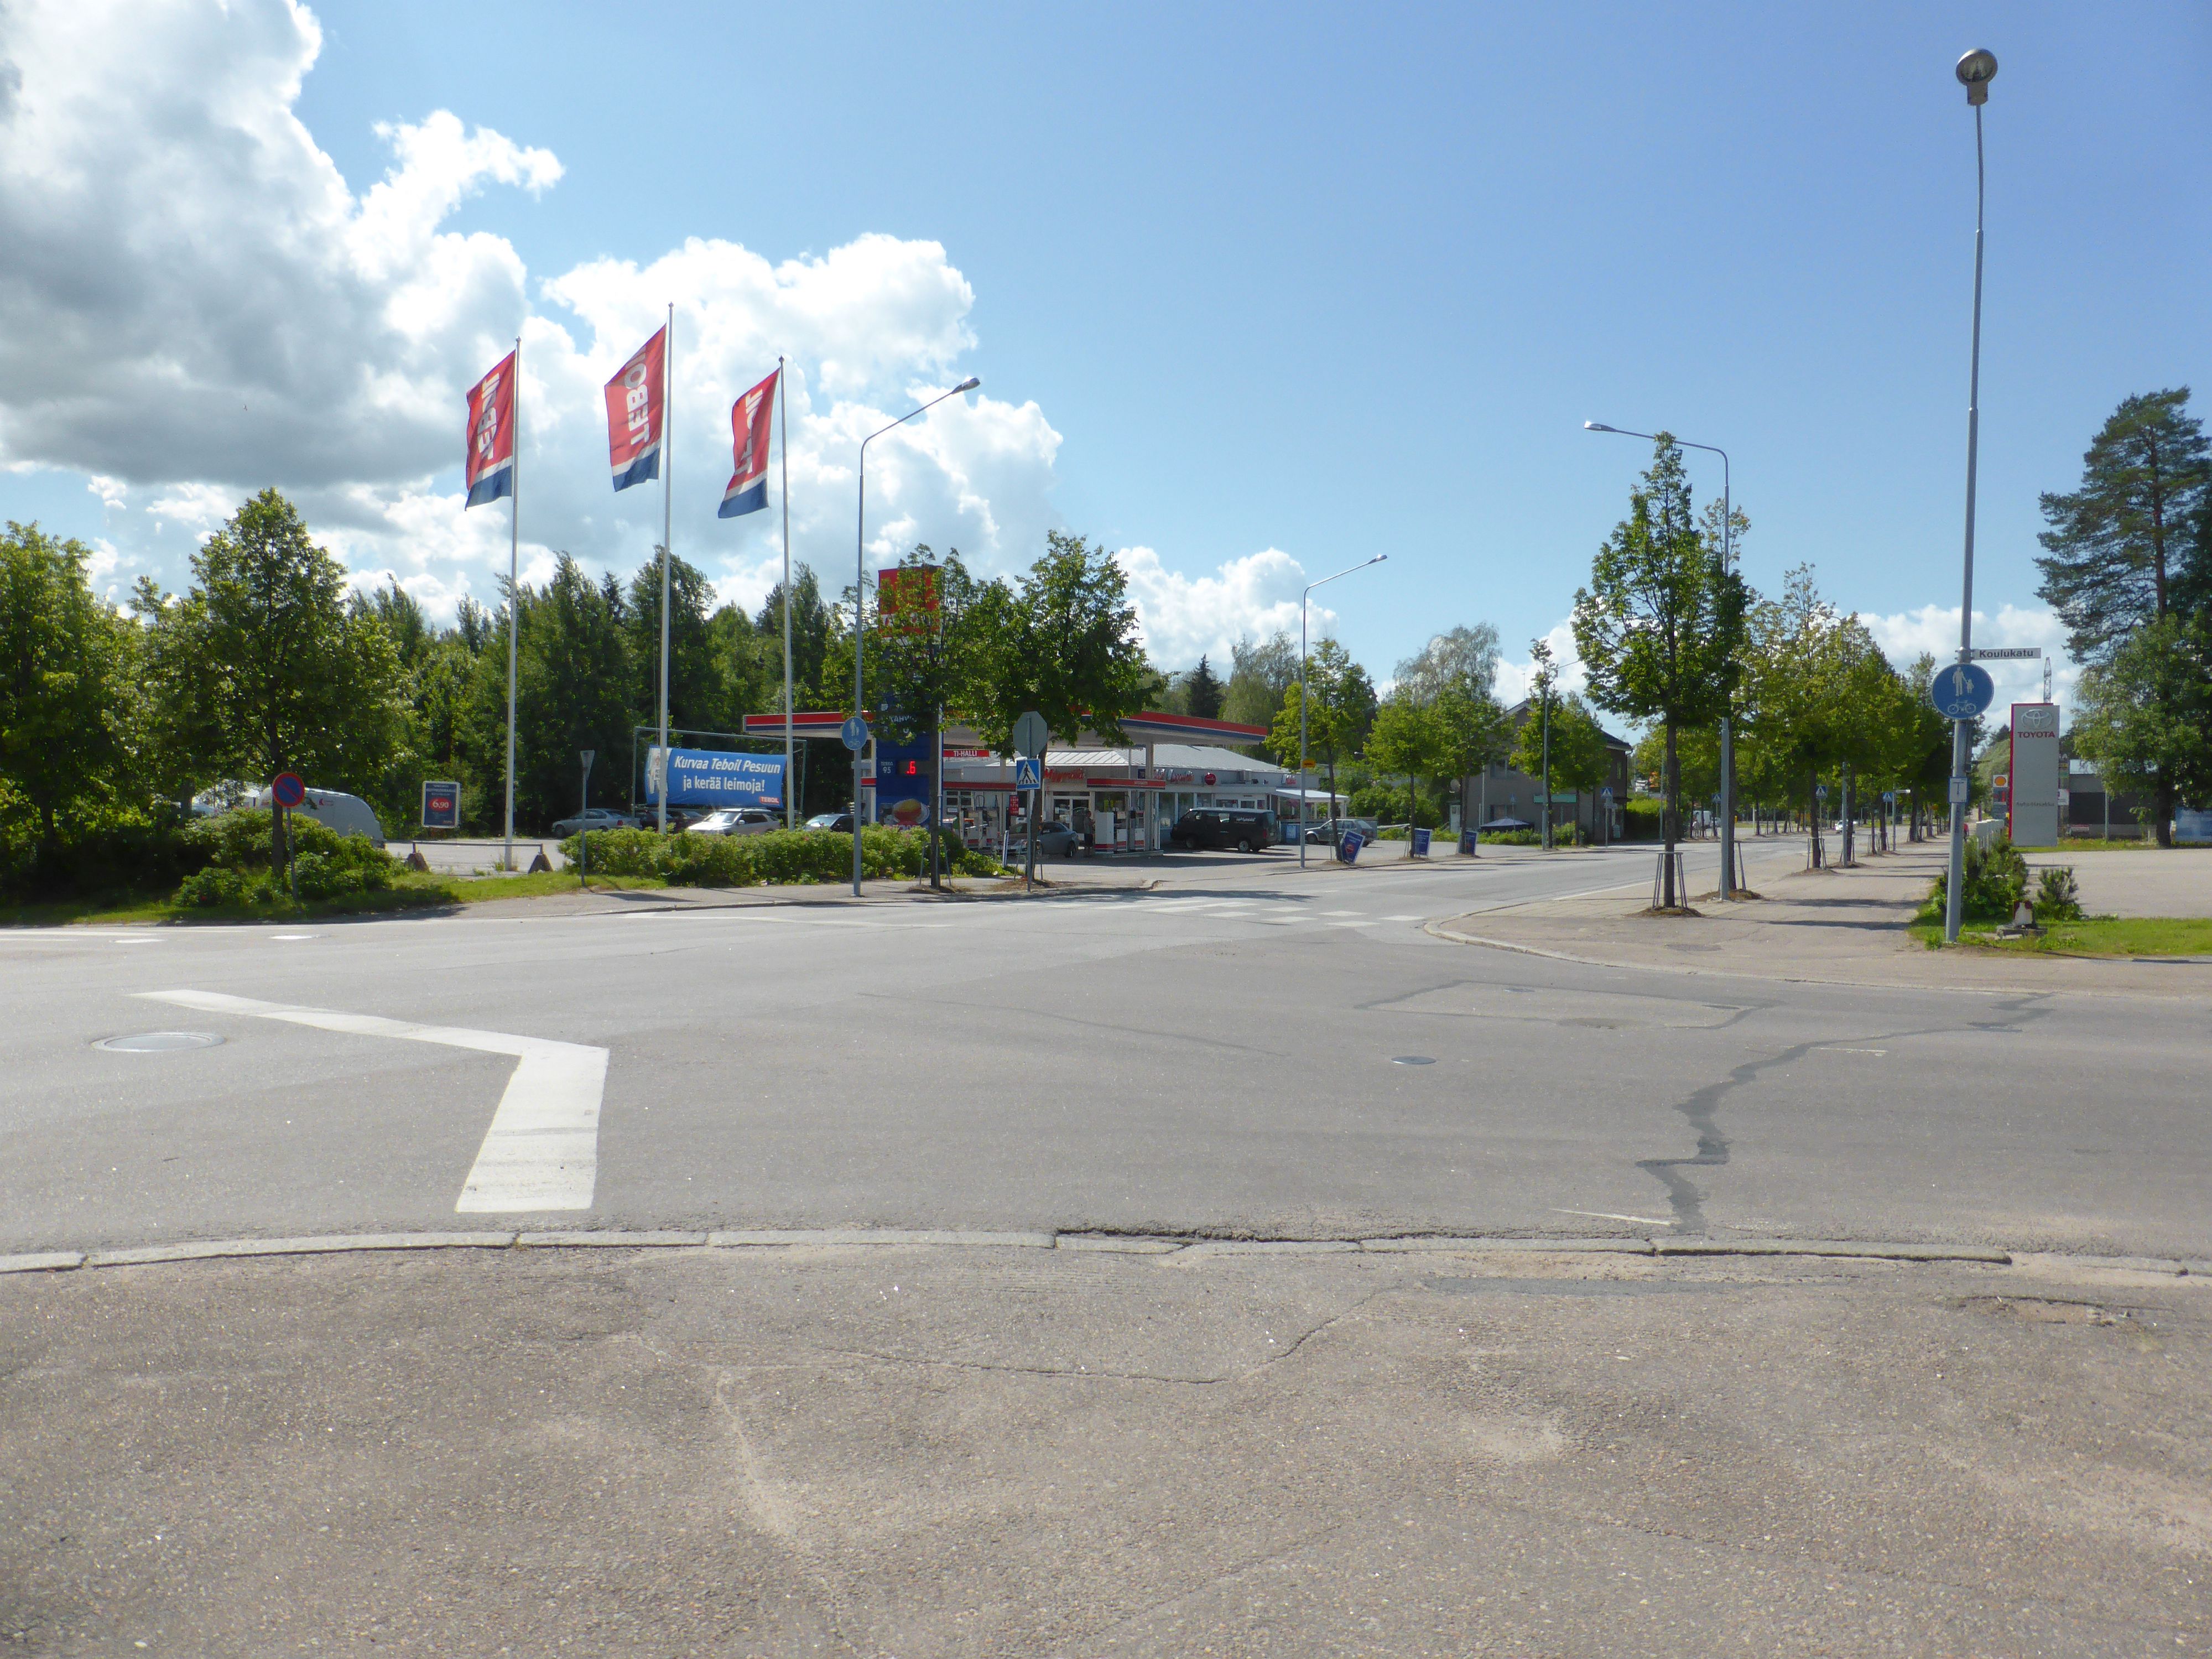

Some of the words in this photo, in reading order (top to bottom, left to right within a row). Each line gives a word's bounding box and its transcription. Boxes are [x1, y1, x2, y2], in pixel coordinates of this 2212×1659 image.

[1979, 649, 2033, 658] Koulukatu
[674, 756, 709, 769] Kurvaa
[711, 758, 741, 771] Teboil
[743, 760, 781, 774] Pesuun
[683, 775, 692, 791] ja
[695, 776, 721, 790] kerää
[724, 777, 765, 794] leimoja!
